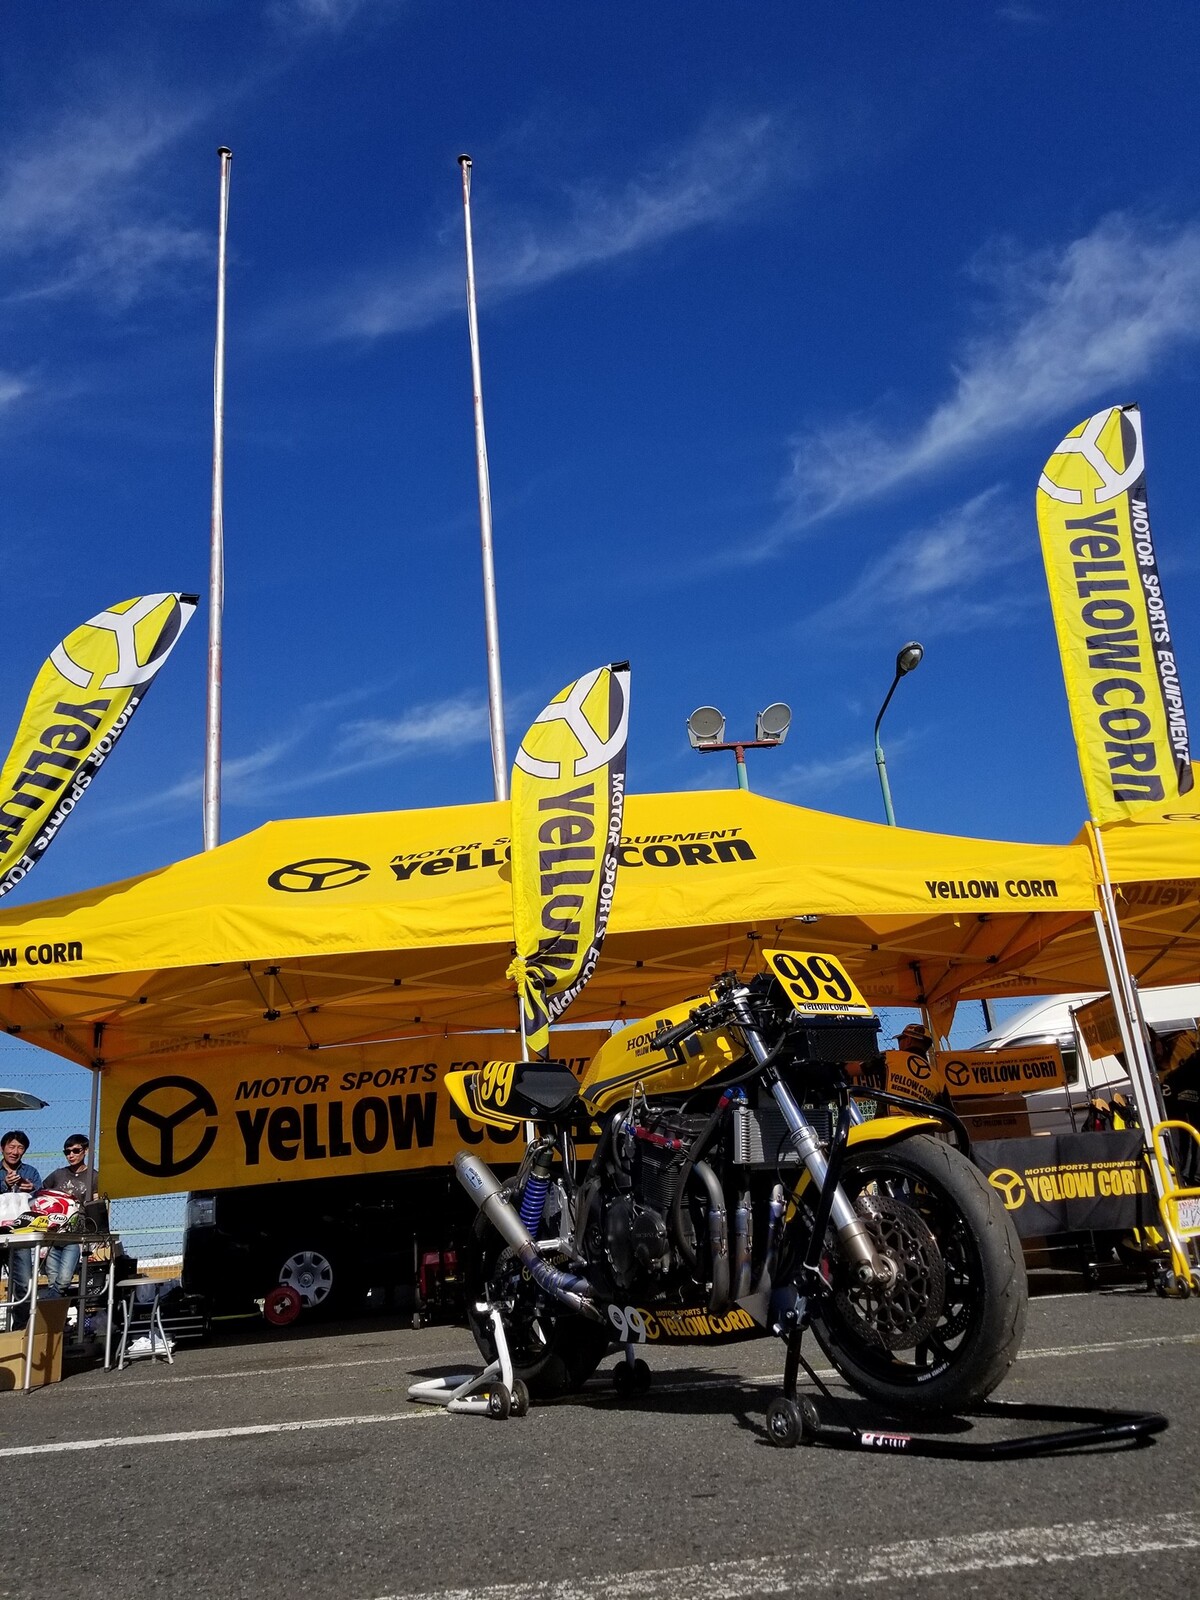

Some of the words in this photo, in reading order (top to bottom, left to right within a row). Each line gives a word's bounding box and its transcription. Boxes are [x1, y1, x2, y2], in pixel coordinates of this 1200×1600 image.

[1131, 499, 1155, 567] MOTOR
[1142, 573, 1170, 643] SPORTS
[1157, 650, 1190, 766] EQUIPMENT
[34, 771, 93, 851] SPORTS
[608, 773, 625, 847] MOTOR
[619, 827, 743, 845] QUIPMENT
[389, 842, 483, 864] MOTOR
[595, 854, 619, 940] SPORTS
[547, 946, 601, 1024] EQUIPM
[772, 953, 853, 1002] 99
[235, 1074, 330, 1100] MOTOR
[339, 1063, 438, 1092] SPORTS
[480, 1060, 516, 1107] 99
[1024, 1167, 1057, 1176] MOTOR
[1058, 1163, 1089, 1172] SPORTS
[1091, 1160, 1141, 1170] EQUIPMENT
[608, 1304, 647, 1343] 99
